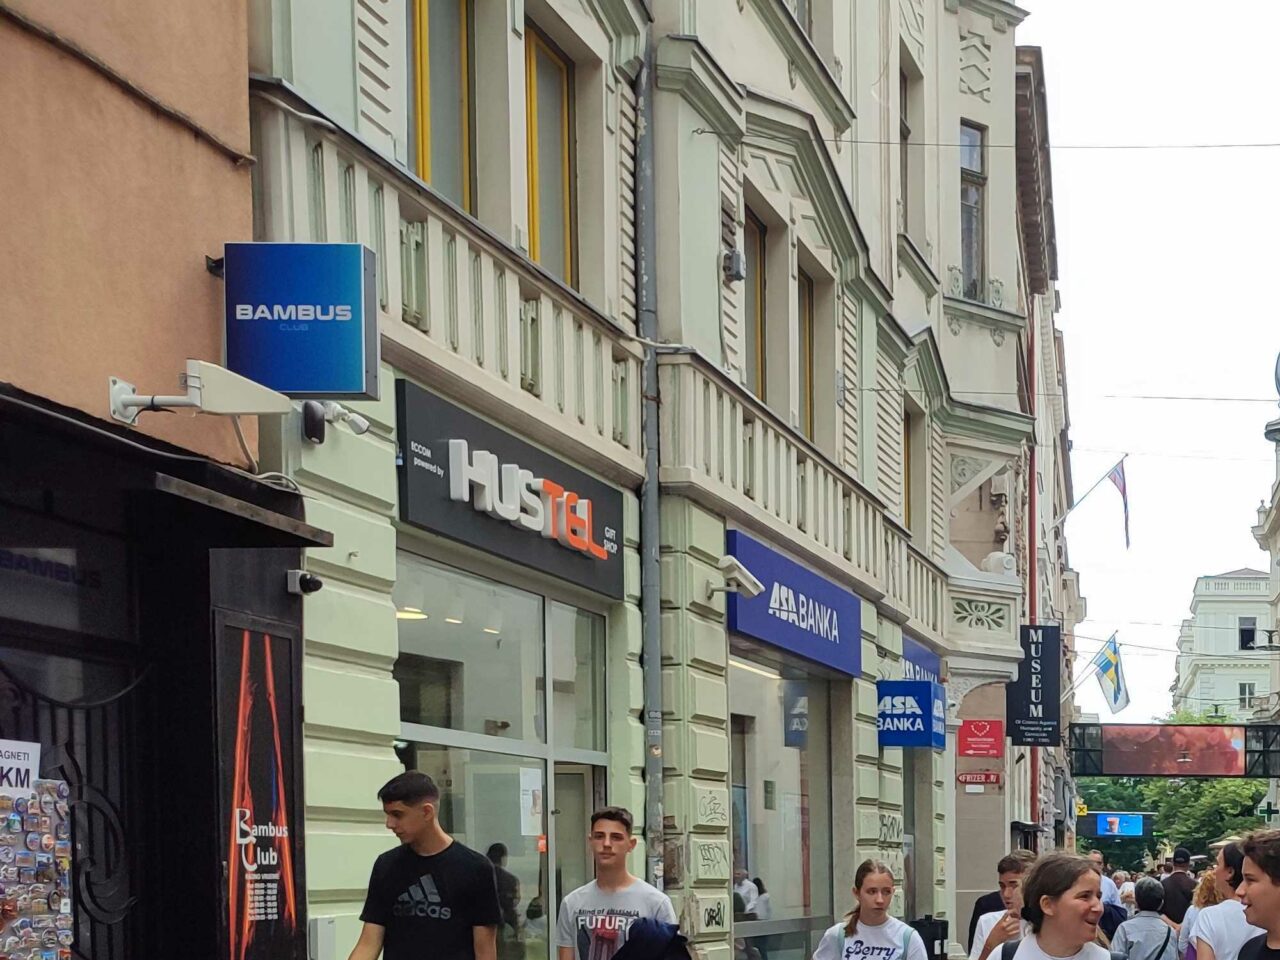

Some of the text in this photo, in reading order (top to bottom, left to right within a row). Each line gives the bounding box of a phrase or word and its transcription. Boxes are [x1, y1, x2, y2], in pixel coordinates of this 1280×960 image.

[235, 304, 352, 321] BAMBUS
[279, 323, 309, 331] CLUB
[413, 456, 444, 478] powered by
[604, 526, 616, 539] GIFT
[603, 538, 618, 554] SHOP
[768, 581, 840, 644] ASA BANKA
[1029, 629, 1043, 718] MUSEUM
[878, 695, 923, 714] ASA
[876, 717, 924, 731] BANKA
[0, 766, 30, 789] KM
[961, 774, 986, 782] FRIZER
[235, 808, 288, 845] Bambus
[241, 843, 278, 871] Club
[393, 900, 452, 920] adidas
[845, 940, 896, 960] Berry
